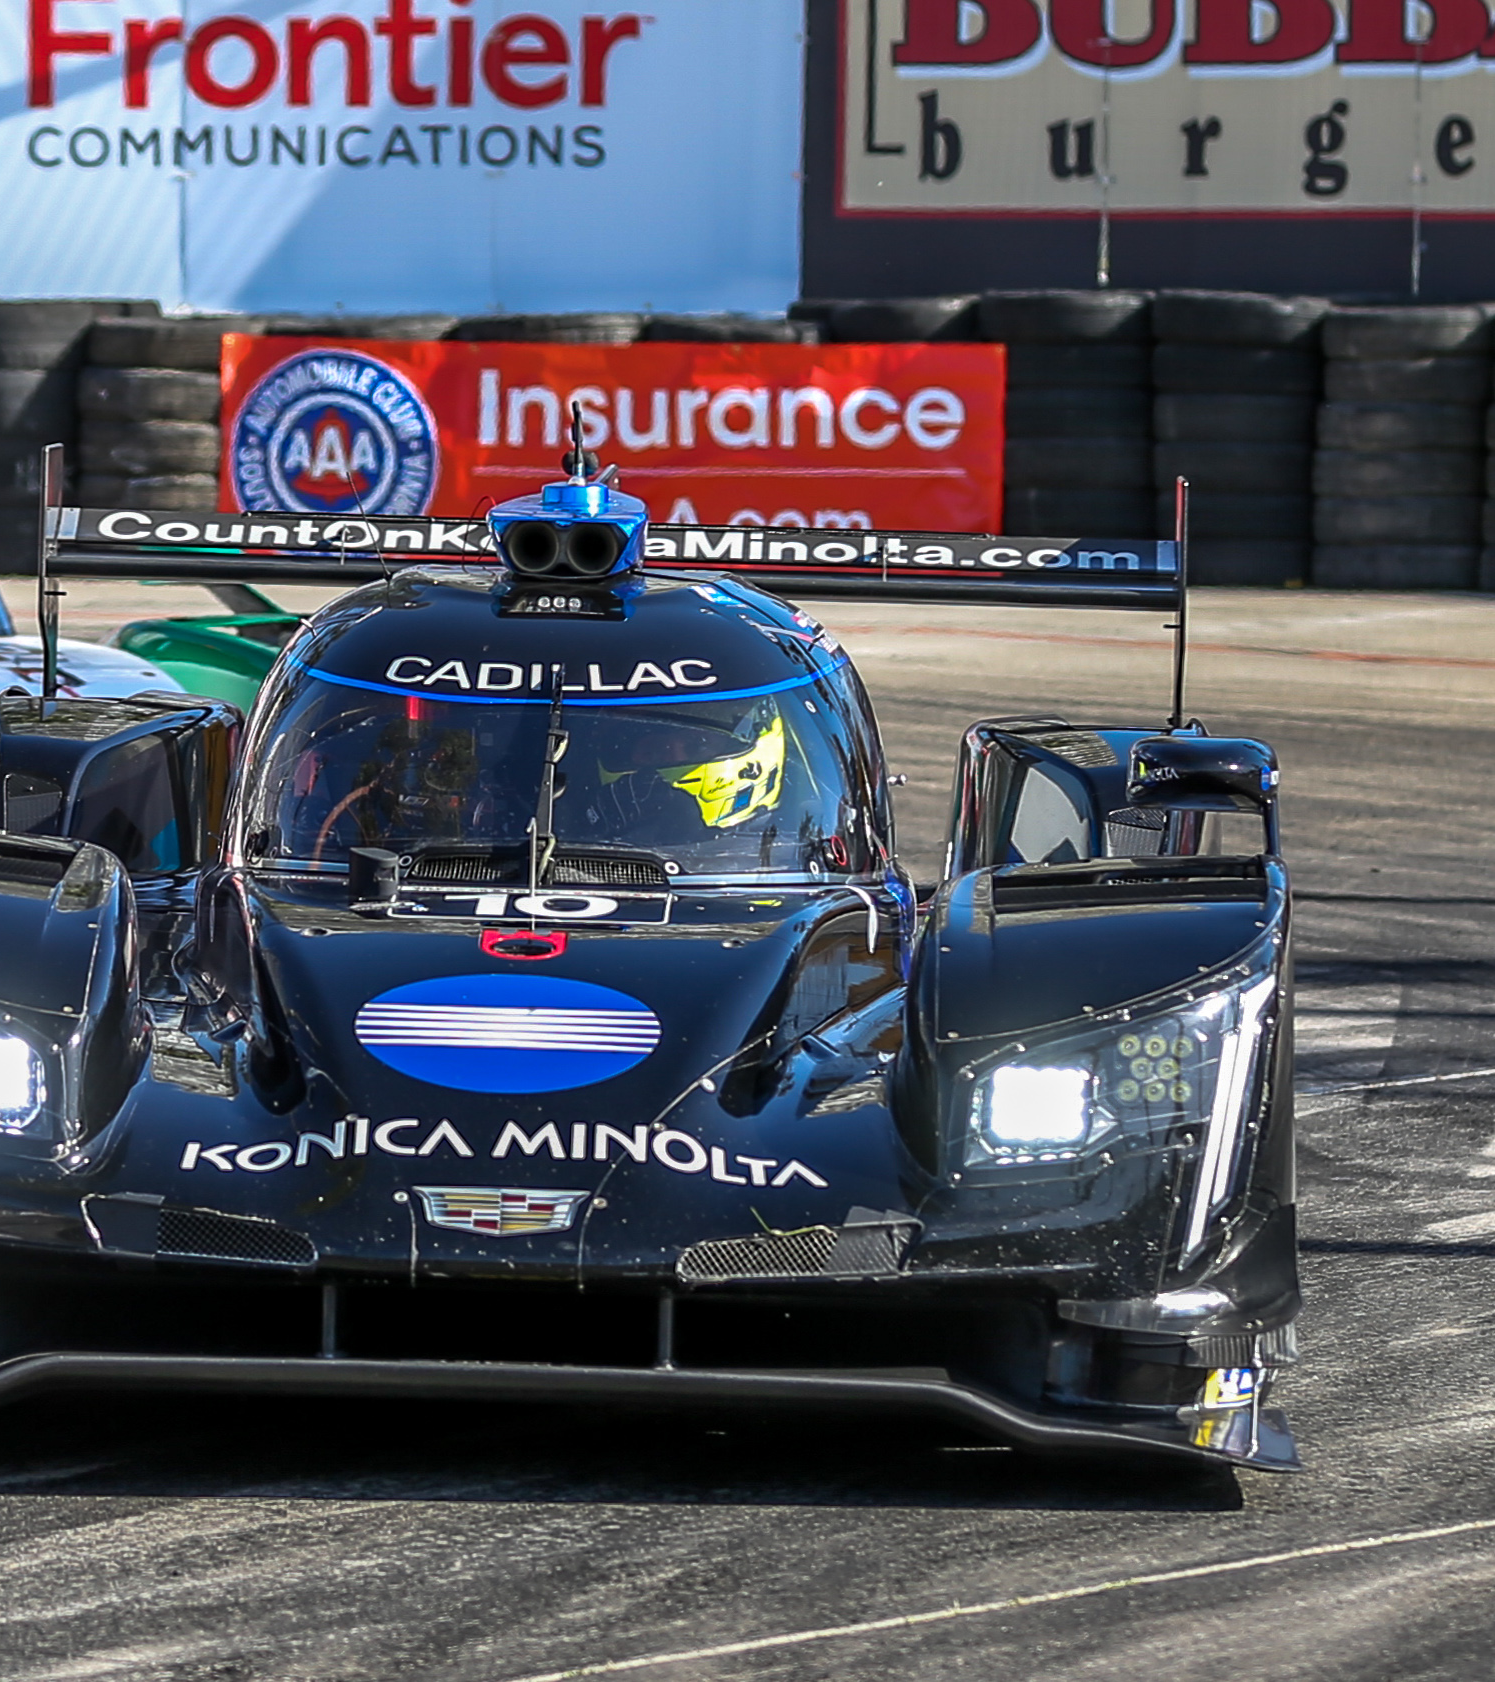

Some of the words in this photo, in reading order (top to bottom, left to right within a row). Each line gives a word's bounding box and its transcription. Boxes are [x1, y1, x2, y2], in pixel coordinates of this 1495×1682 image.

[27, 0, 640, 109] Frontier
[27, 124, 606, 168] COMMUNICATIONS
[478, 368, 967, 450] Insurance
[284, 424, 377, 481] AAA
[385, 656, 718, 691] CADILLAC
[180, 1118, 474, 1172] KONICA
[491, 1121, 829, 1188] MINOLTA
